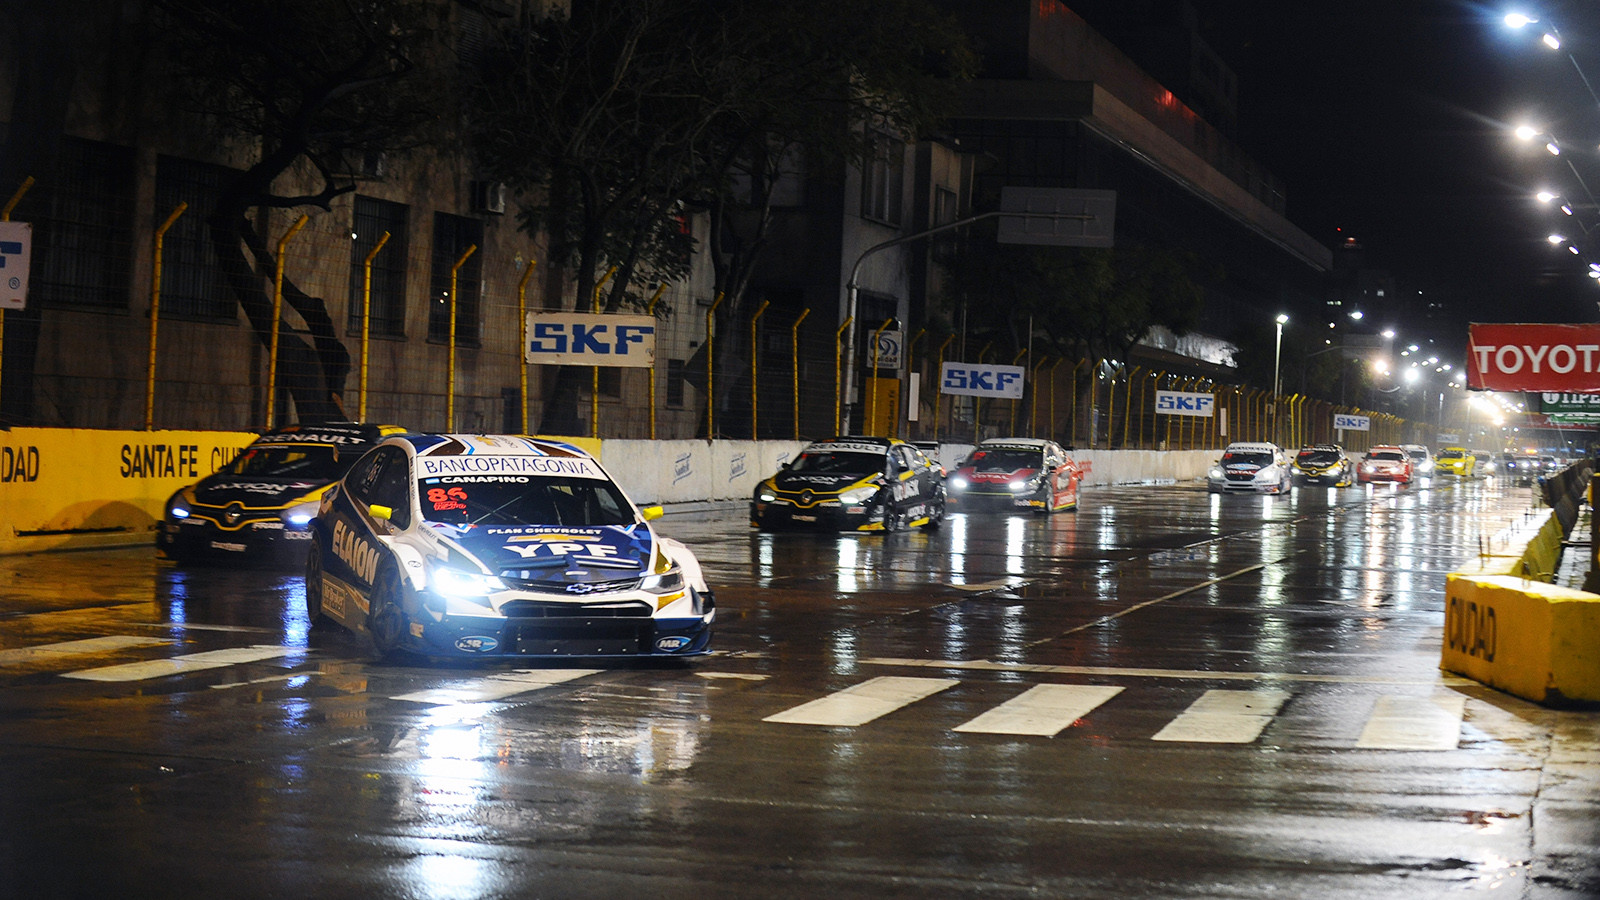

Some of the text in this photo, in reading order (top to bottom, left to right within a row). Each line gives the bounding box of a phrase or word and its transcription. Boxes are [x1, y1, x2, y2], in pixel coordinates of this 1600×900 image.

[531, 323, 654, 354] SKF
[1473, 344, 1600, 374] TOYOT
[944, 369, 1020, 391] SKF
[1158, 396, 1213, 410] SKF
[1336, 417, 1369, 428] SKF
[258, 433, 366, 444] RENAULT
[120, 444, 175, 478] SANTA
[179, 445, 198, 477] FE
[424, 457, 594, 476] BANCOPATAGONIA
[441, 476, 529, 484] CANAPINO
[427, 487, 468, 502] 86
[332, 519, 380, 586] ELAION
[502, 543, 618, 558] YPF
[1449, 596, 1496, 663] CIUDAD
[659, 640, 680, 648] MR
